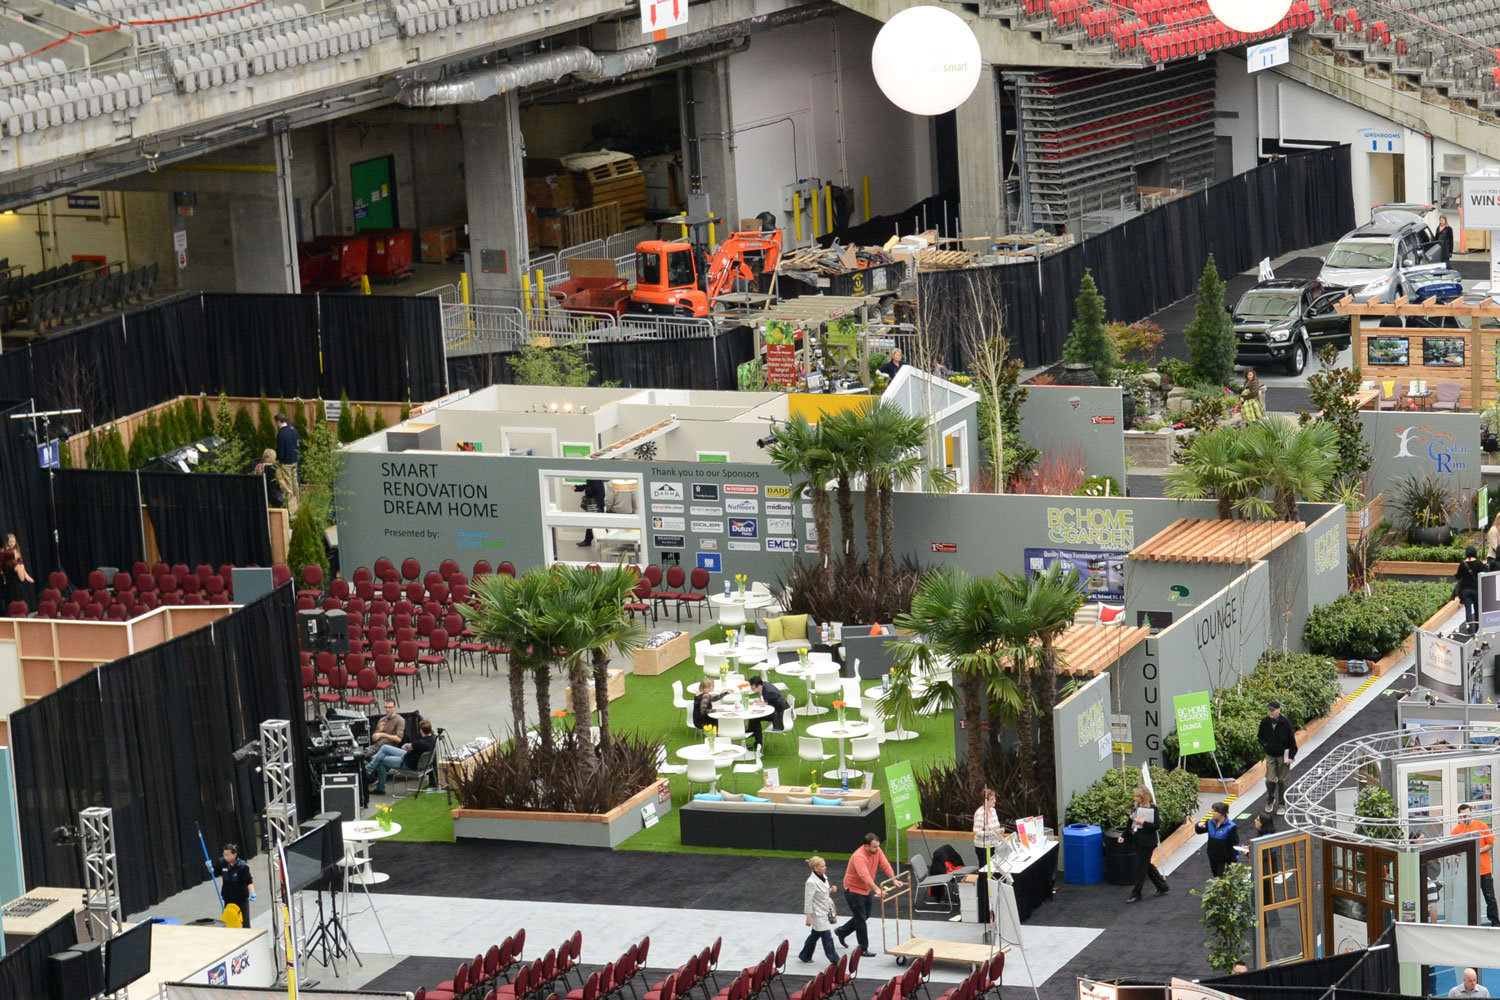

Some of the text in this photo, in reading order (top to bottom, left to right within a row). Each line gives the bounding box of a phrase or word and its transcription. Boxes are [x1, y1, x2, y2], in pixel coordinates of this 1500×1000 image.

[1471, 195, 1495, 206] WIN
[381, 462, 439, 479] SMART
[651, 467, 760, 480] Thank you to our Sponsors
[383, 481, 489, 500] RENOVATION
[383, 500, 499, 519] DREAM HOME
[1047, 507, 1134, 530] BC HOME
[384, 528, 441, 540] Presented by:
[731, 525, 755, 533] Dulux
[1065, 527, 1135, 546] GARDEN
[1197, 597, 1237, 650] LOUNGE
